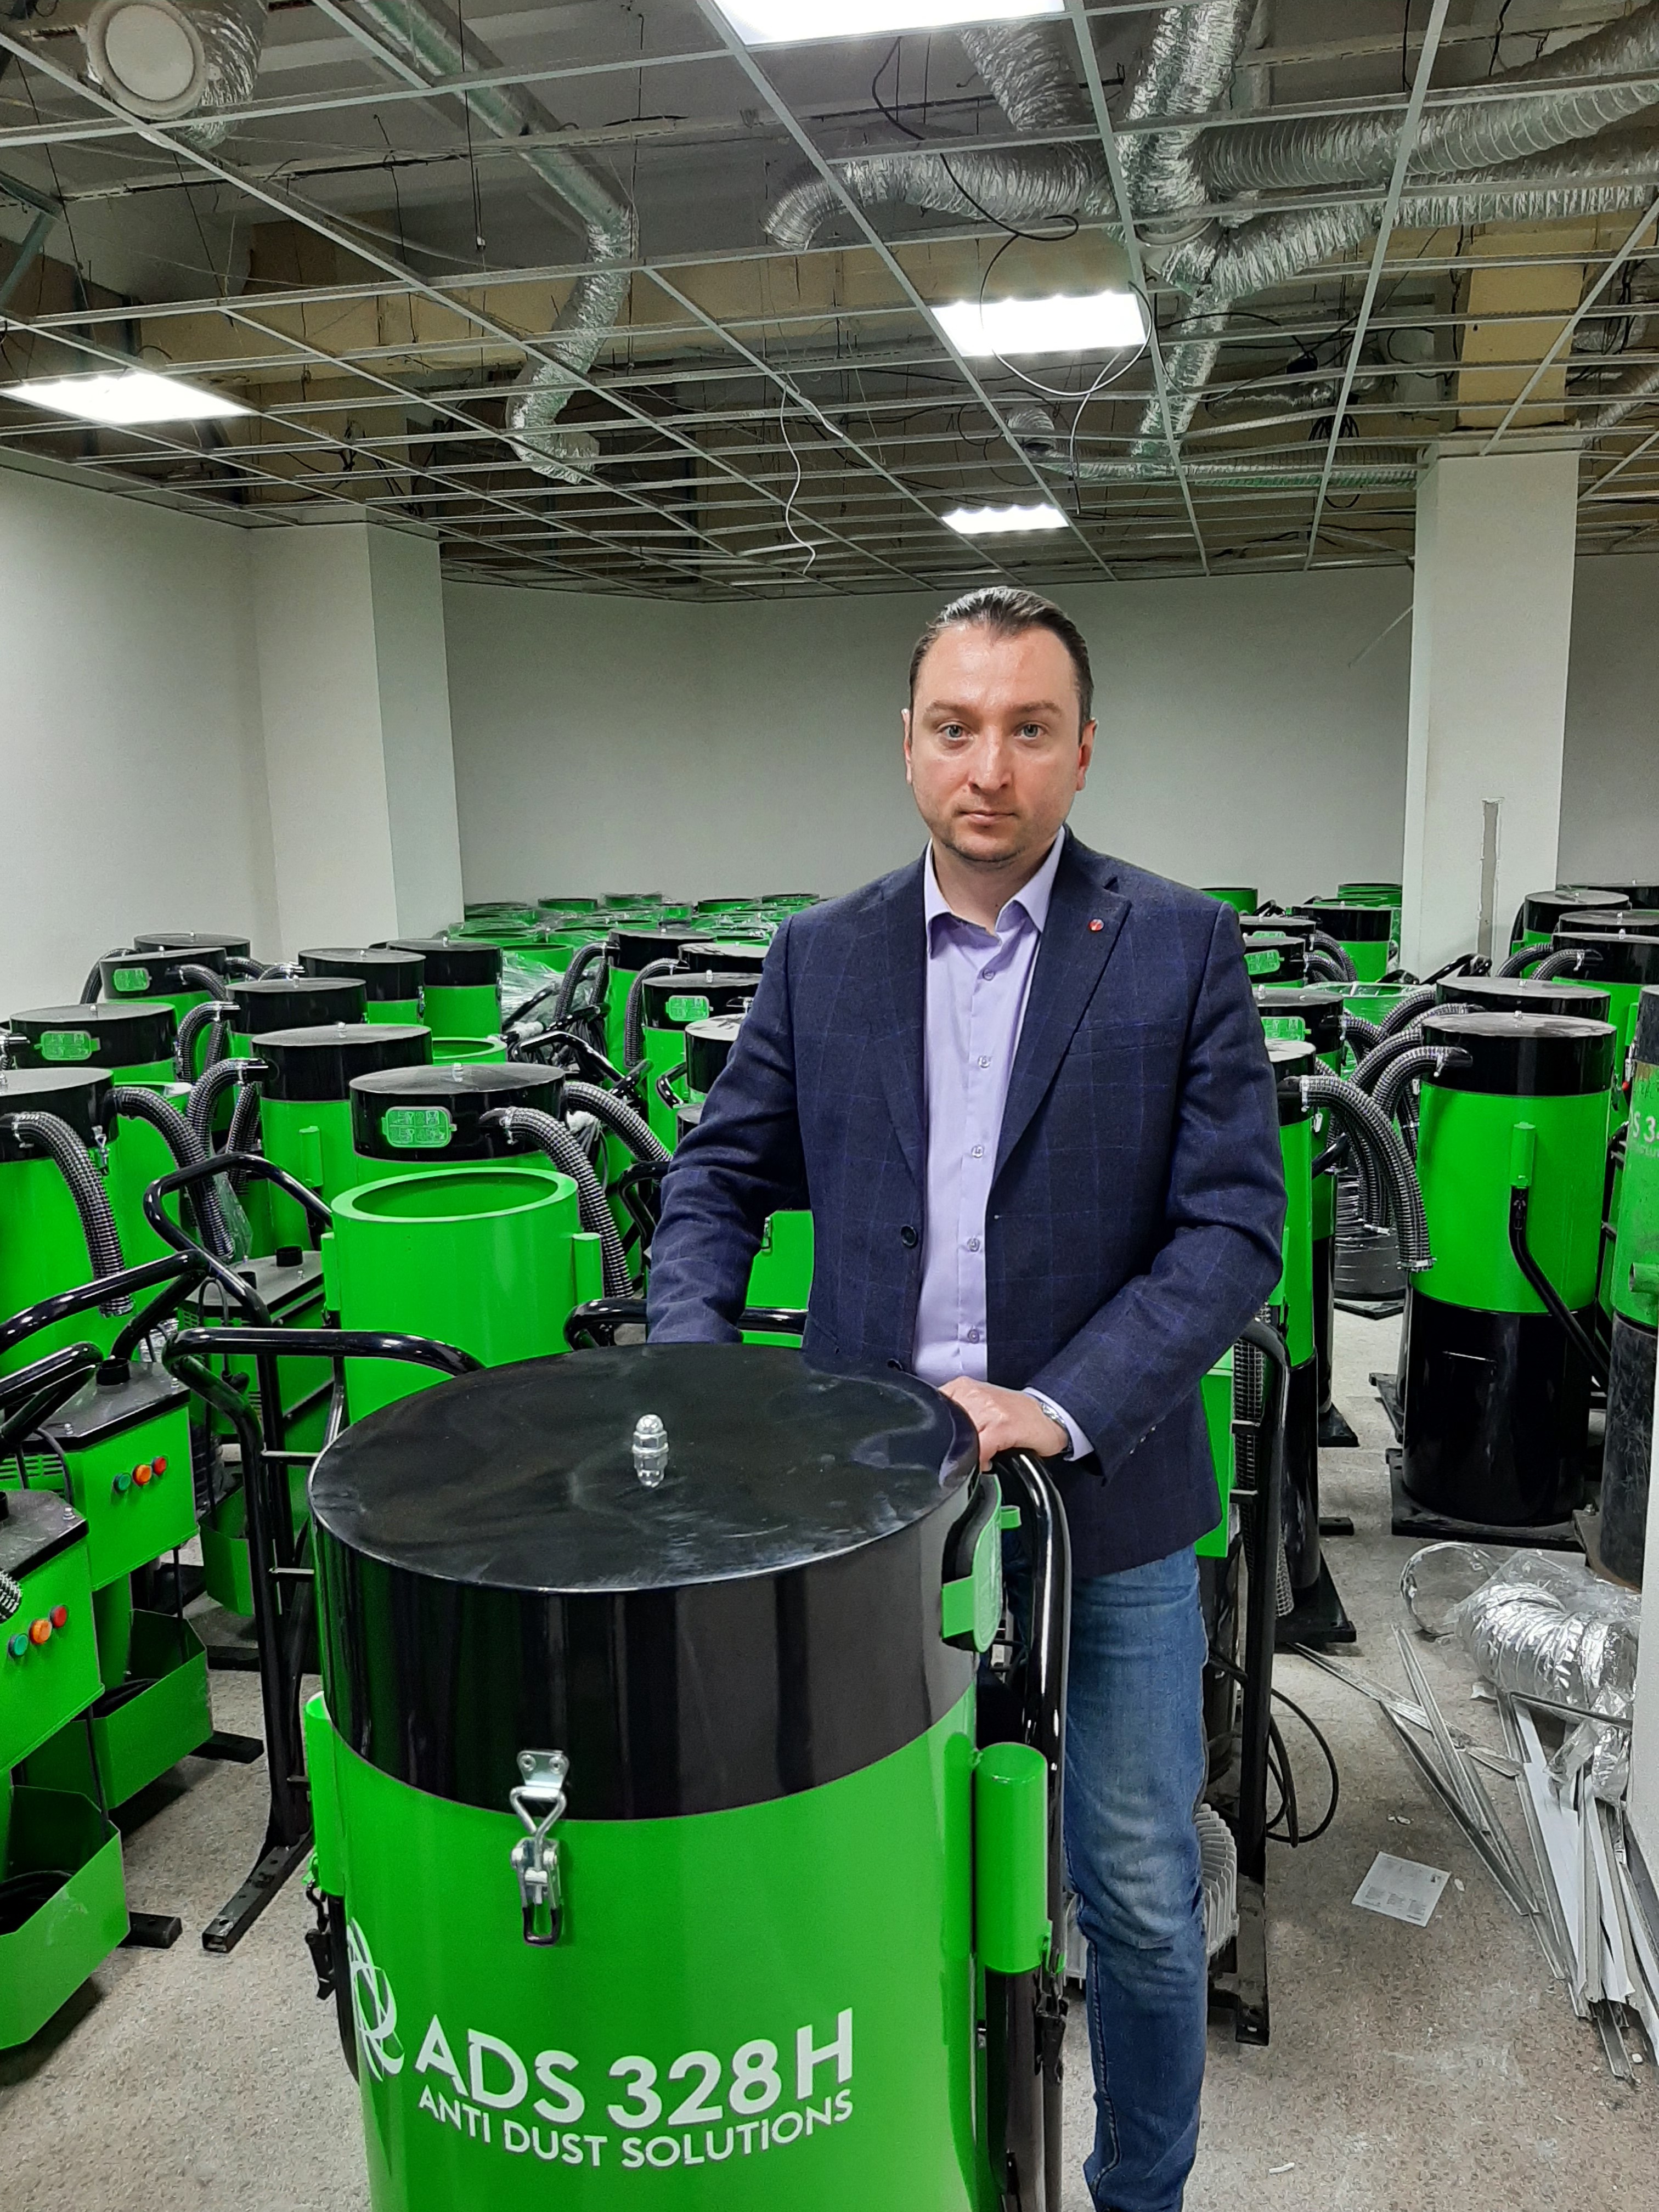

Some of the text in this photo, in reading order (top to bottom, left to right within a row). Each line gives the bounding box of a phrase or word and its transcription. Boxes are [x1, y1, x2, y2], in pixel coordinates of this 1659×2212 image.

[1644, 1116, 1659, 1143] 3
[414, 2015, 585, 2123] ADS
[419, 2086, 853, 2168] ANTI DUST SOLUTIONS
